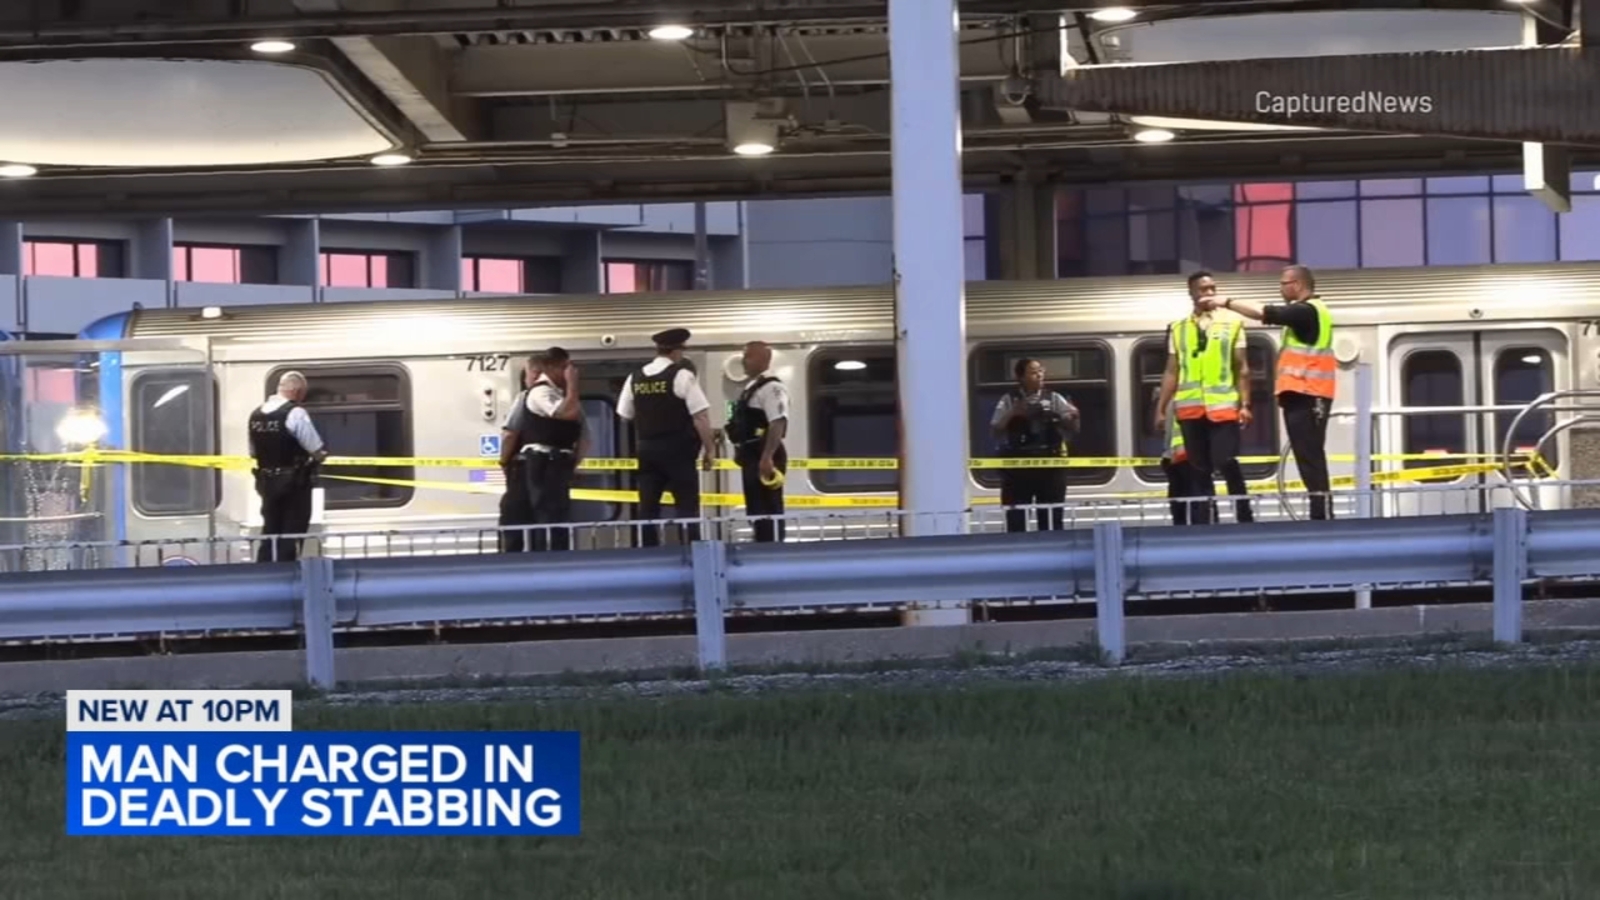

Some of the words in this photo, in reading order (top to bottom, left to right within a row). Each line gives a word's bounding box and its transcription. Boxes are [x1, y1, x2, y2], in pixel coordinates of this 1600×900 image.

[465, 354, 510, 371] 7127
[634, 381, 668, 395] POLICE
[250, 420, 280, 432] POLICE
